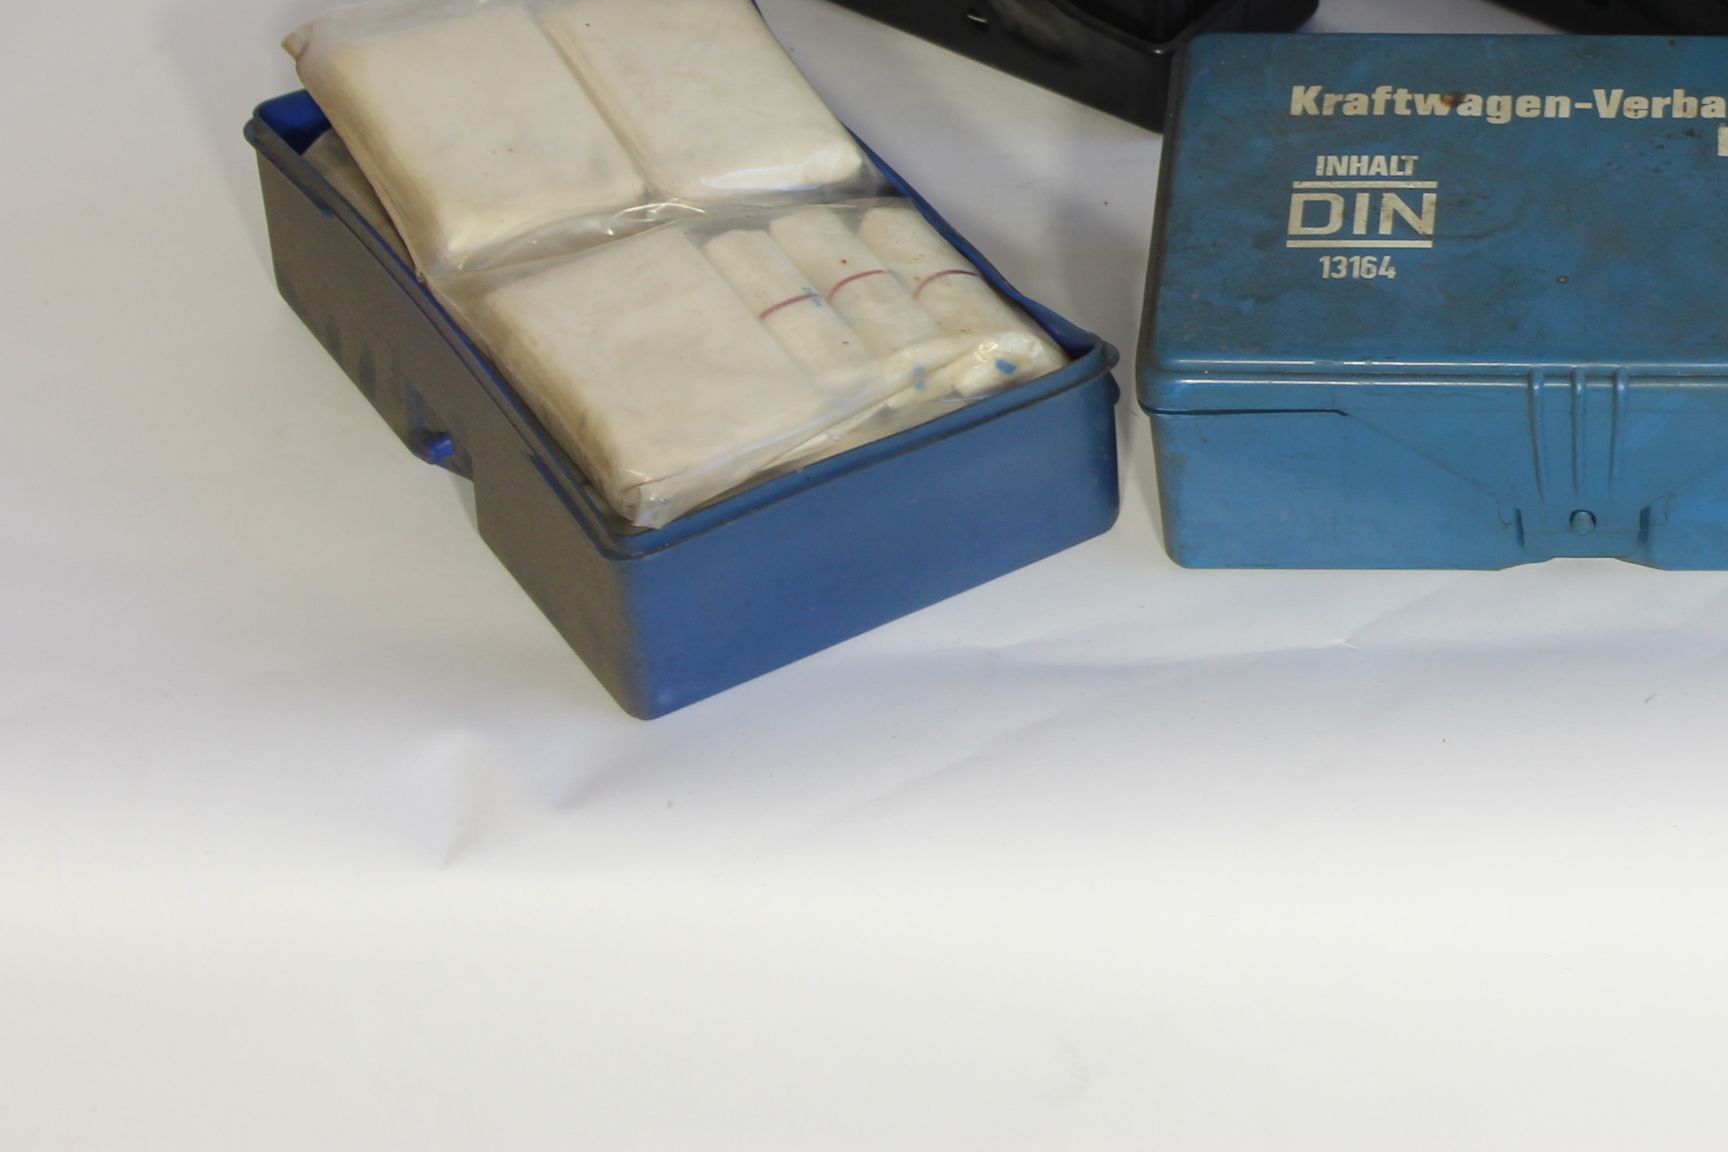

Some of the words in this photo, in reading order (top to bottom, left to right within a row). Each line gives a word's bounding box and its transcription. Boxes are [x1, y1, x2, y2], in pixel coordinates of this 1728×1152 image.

[1315, 154, 1418, 176] INHALT
[1287, 192, 1437, 235] DIN
[1319, 255, 1396, 279] 13164
